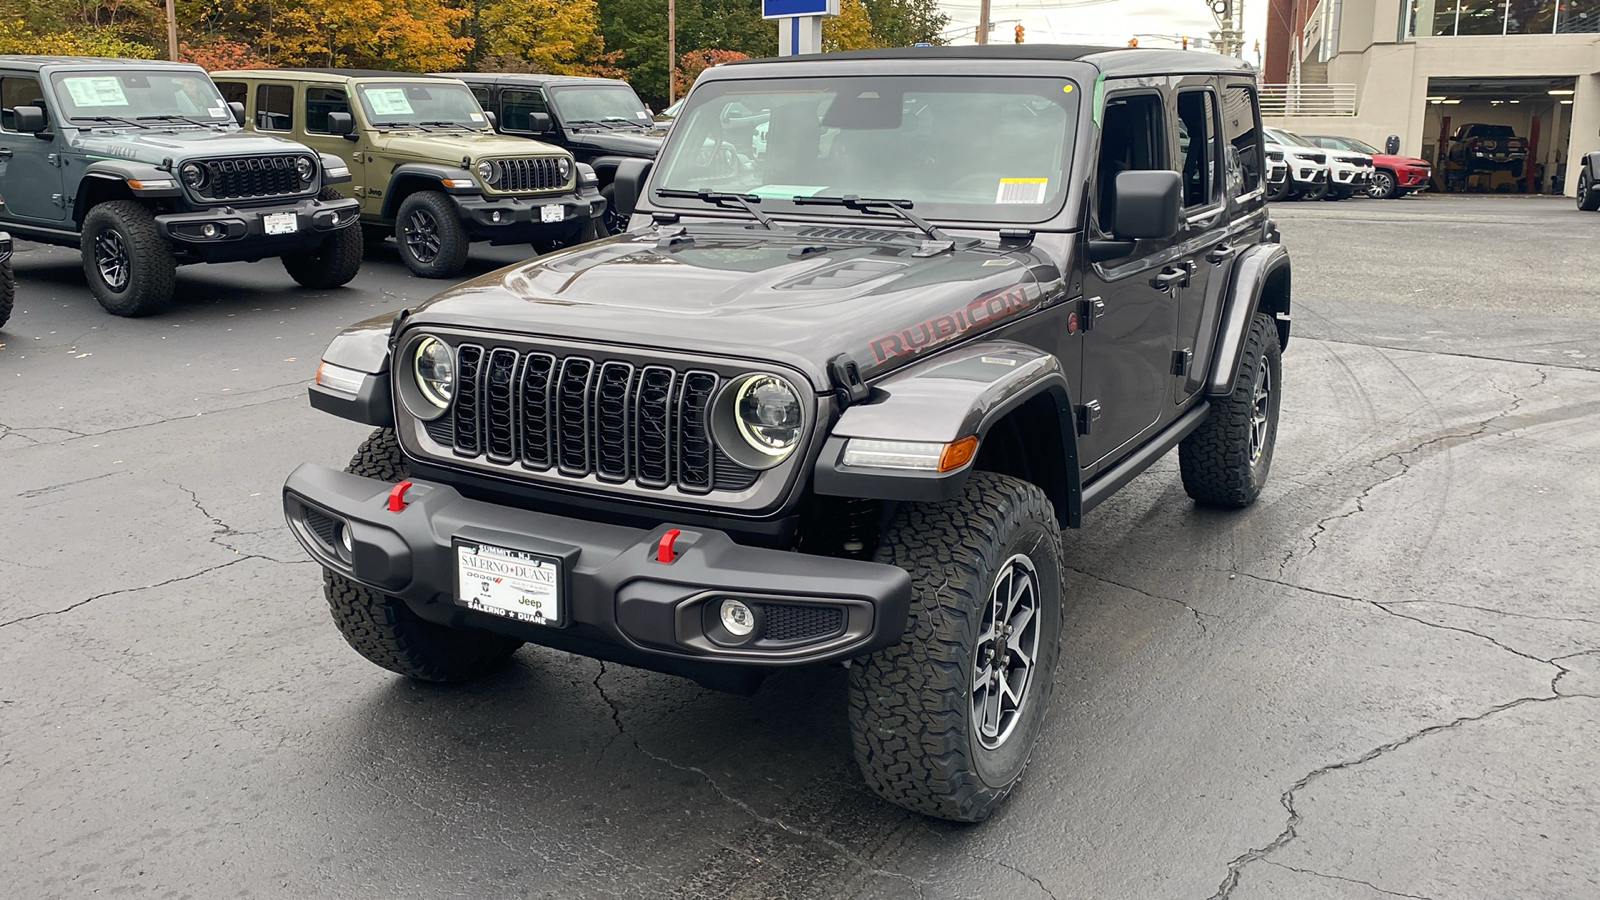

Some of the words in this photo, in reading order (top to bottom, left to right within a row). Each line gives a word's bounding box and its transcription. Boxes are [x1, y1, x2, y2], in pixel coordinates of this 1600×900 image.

[106, 144, 139, 158] WILLYS
[868, 286, 1030, 364] RUBICON
[518, 551, 531, 561] NJ
[461, 554, 509, 574] SALERNO
[514, 565, 555, 584] DUANE
[518, 595, 543, 609] Jeep
[467, 601, 506, 616] SALERNO
[517, 611, 547, 626] DUANE
